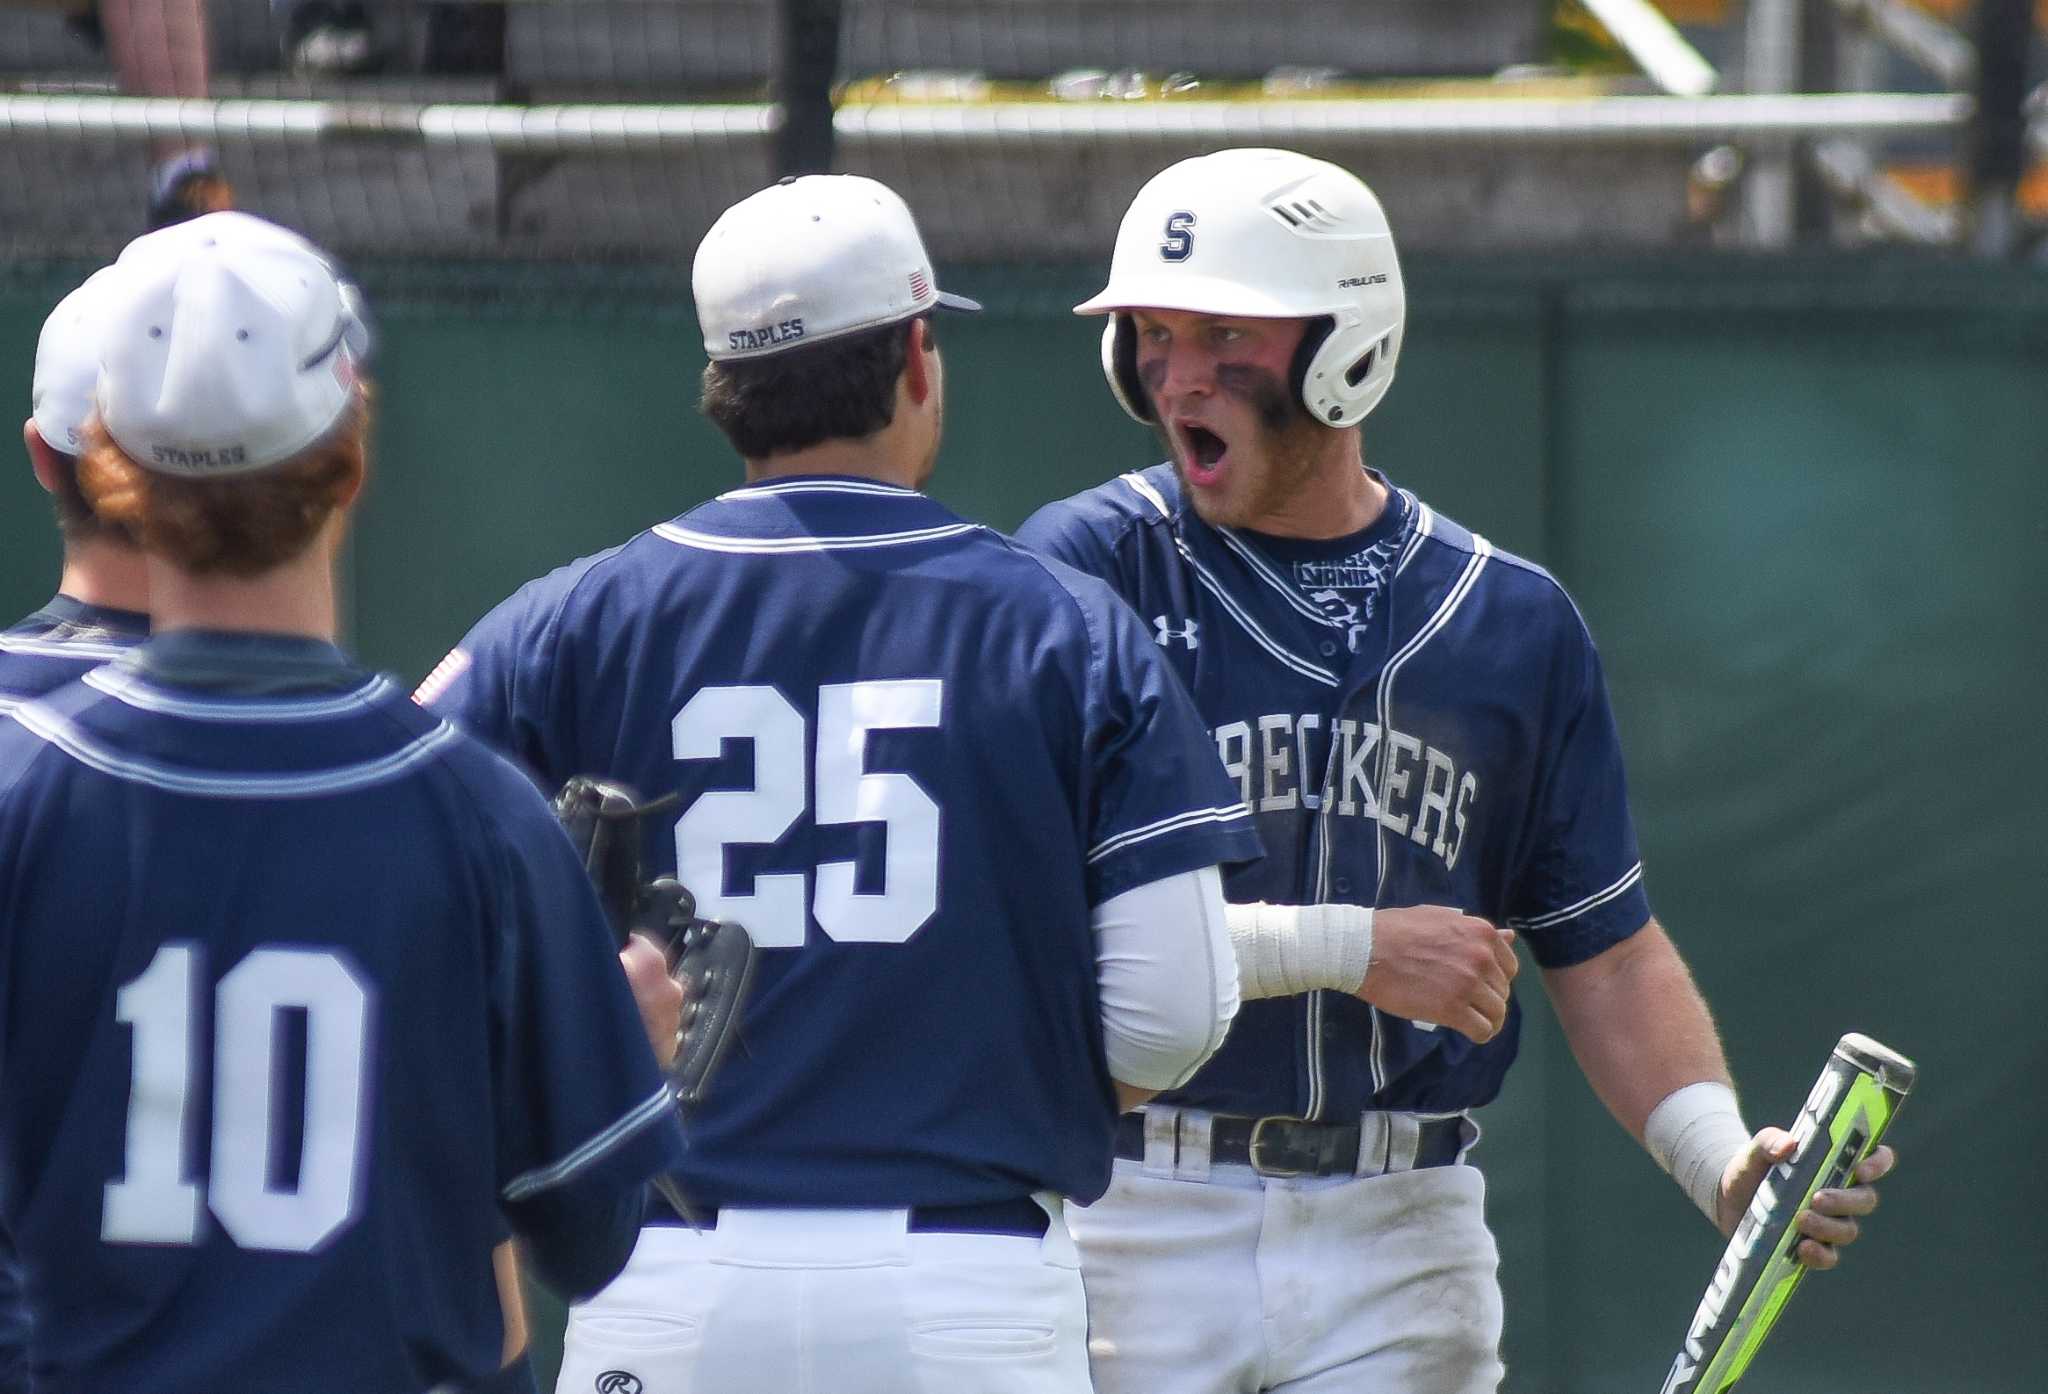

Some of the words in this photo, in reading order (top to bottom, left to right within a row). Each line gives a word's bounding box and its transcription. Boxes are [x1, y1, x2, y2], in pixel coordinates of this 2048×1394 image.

[1159, 209, 1197, 263] S
[728, 318, 804, 350] STAPLES
[151, 444, 246, 468] STAPLES
[671, 679, 943, 948] 25
[1206, 712, 1476, 872] RECKERS
[100, 946, 366, 1253] 10
